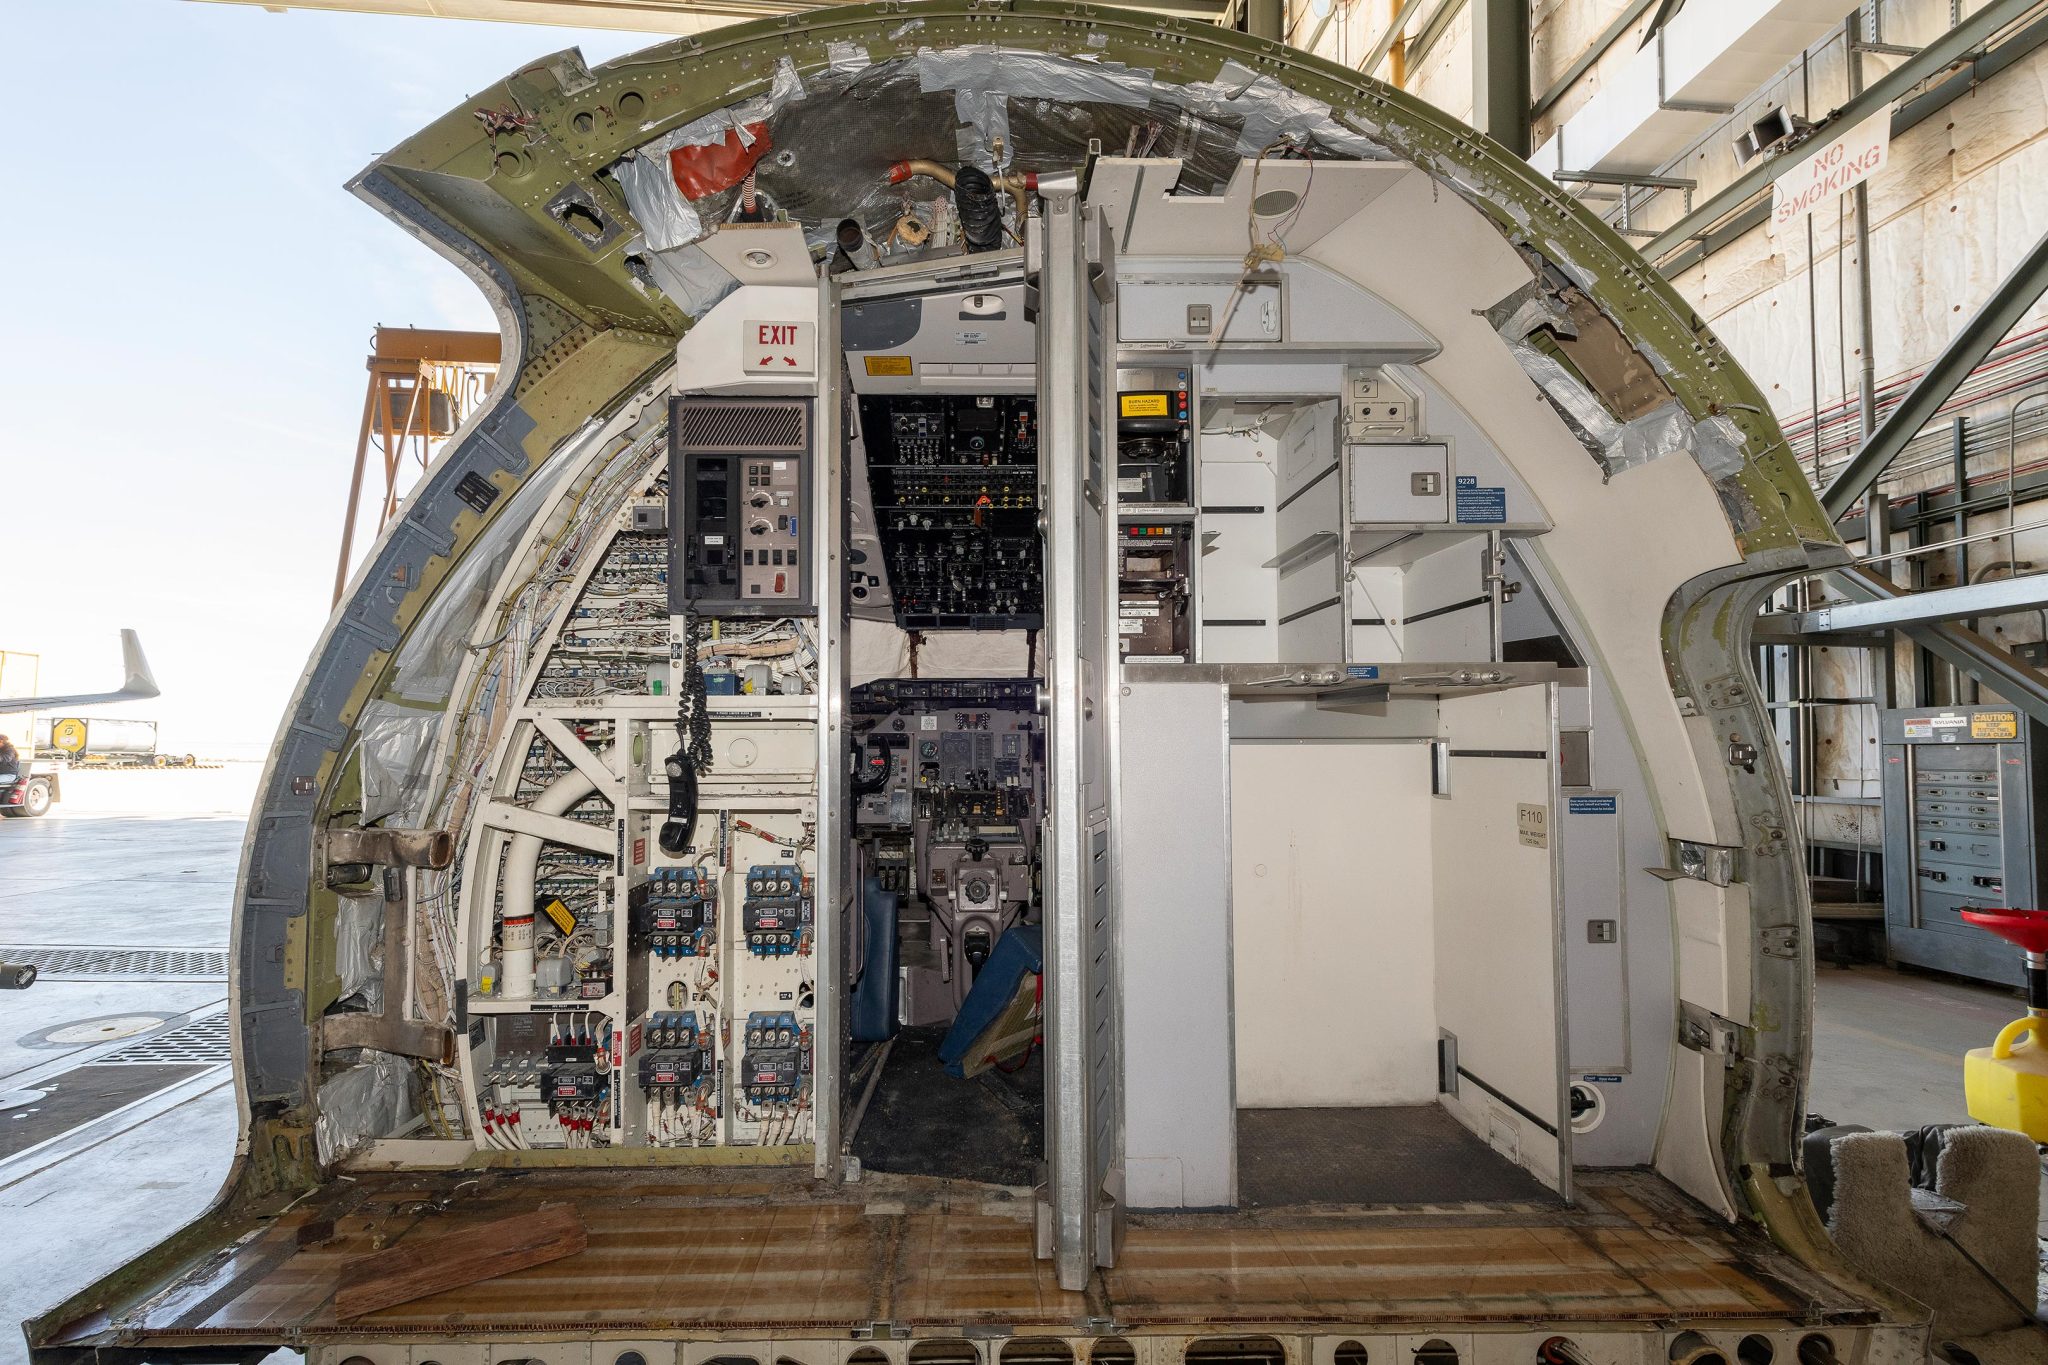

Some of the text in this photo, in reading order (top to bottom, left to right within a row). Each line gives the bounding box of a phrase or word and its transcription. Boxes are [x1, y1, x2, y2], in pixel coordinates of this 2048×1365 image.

[1814, 144, 1844, 178] NO
[1778, 145, 1880, 223] SMOKING
[759, 325, 798, 345] EXIT
[1520, 810, 1542, 823] F110
